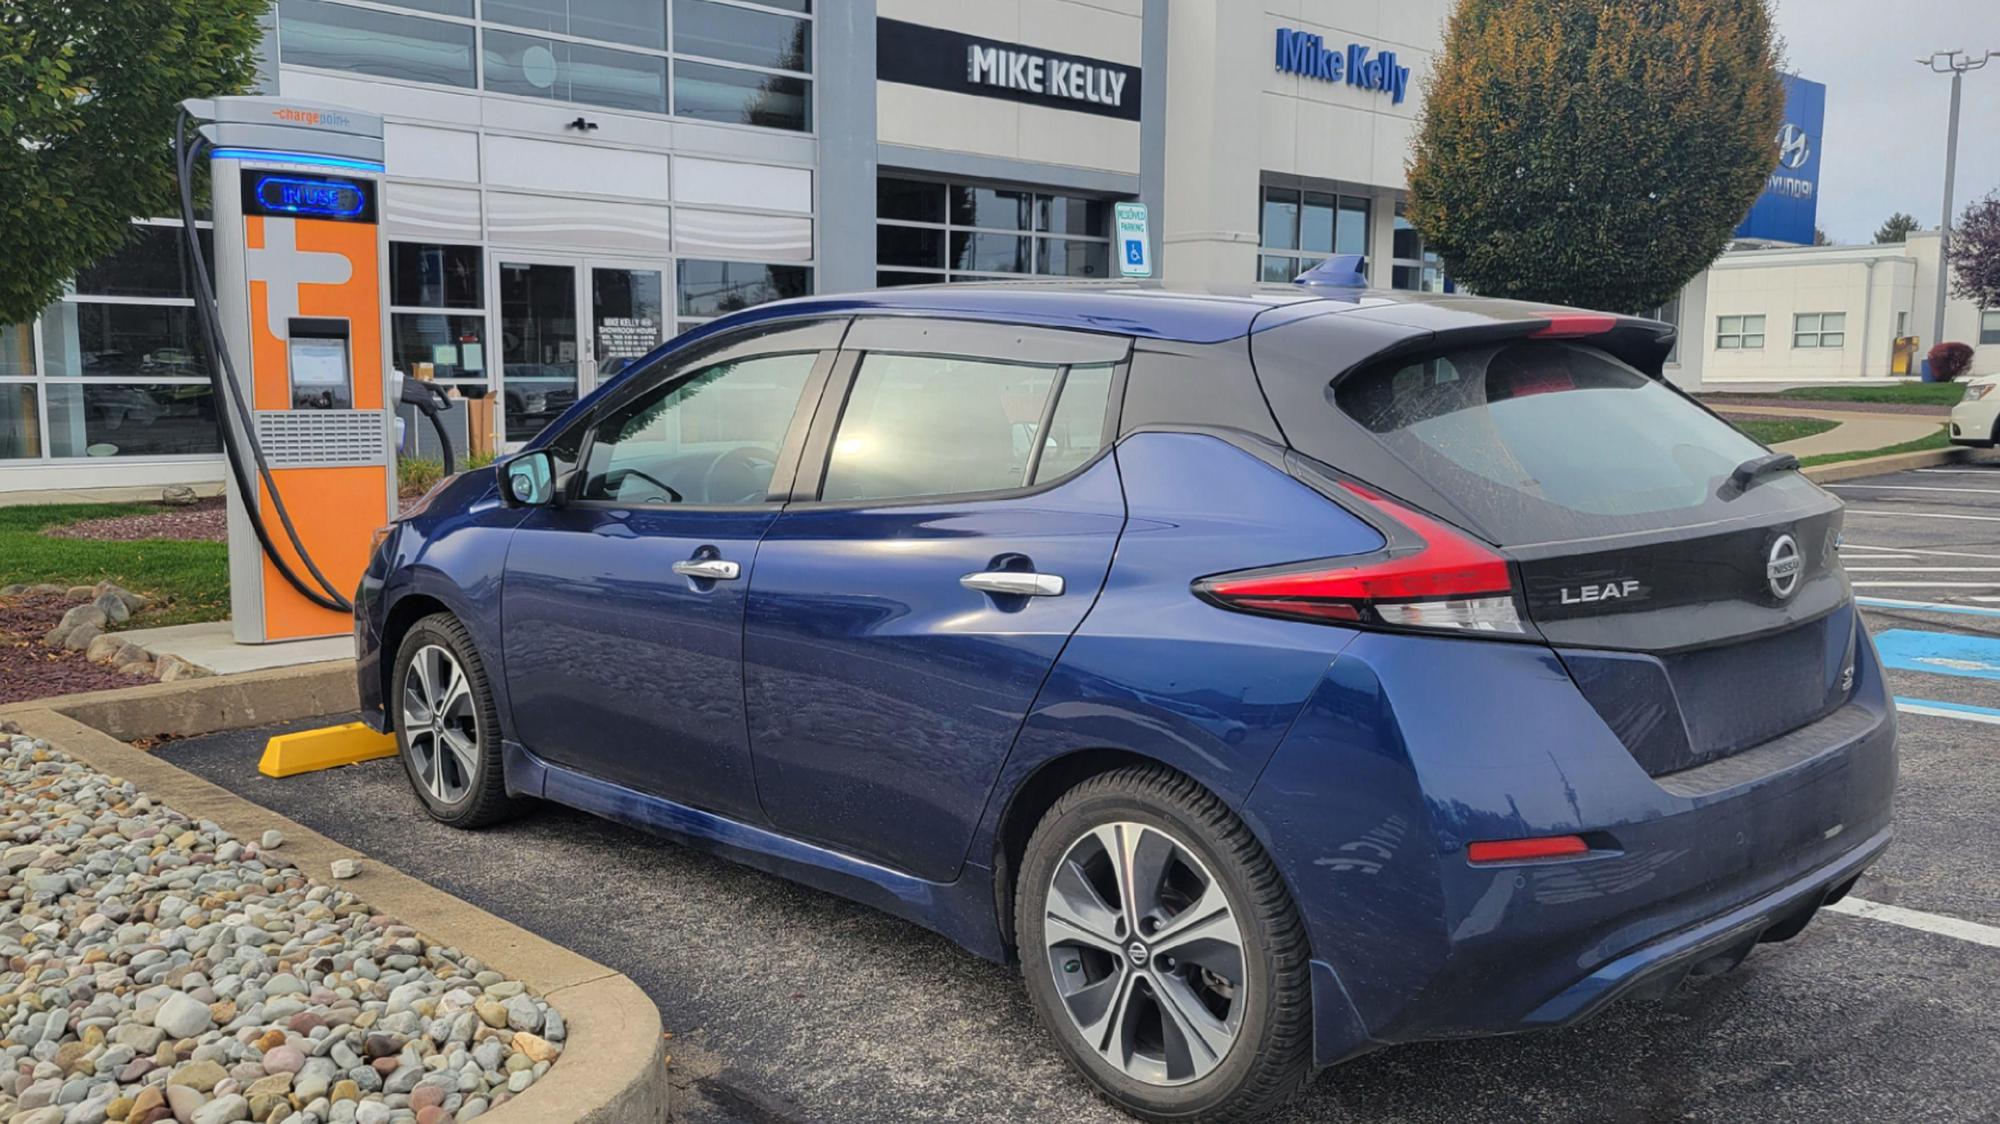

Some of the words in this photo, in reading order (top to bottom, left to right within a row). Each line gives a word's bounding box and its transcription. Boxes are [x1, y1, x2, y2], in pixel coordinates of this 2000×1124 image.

[968, 45, 1044, 93] MIKE
[1046, 59, 1127, 106] KELLY
[1275, 28, 1344, 82] Mike
[1346, 44, 1410, 105] Kelly
[283, 186, 301, 204] IN
[304, 189, 338, 209] USE
[1119, 210, 1145, 220] RESERVED
[1120, 222, 1145, 232] PARKING
[620, 318, 639, 327] KELLY
[1560, 581, 1640, 604] LEAF
